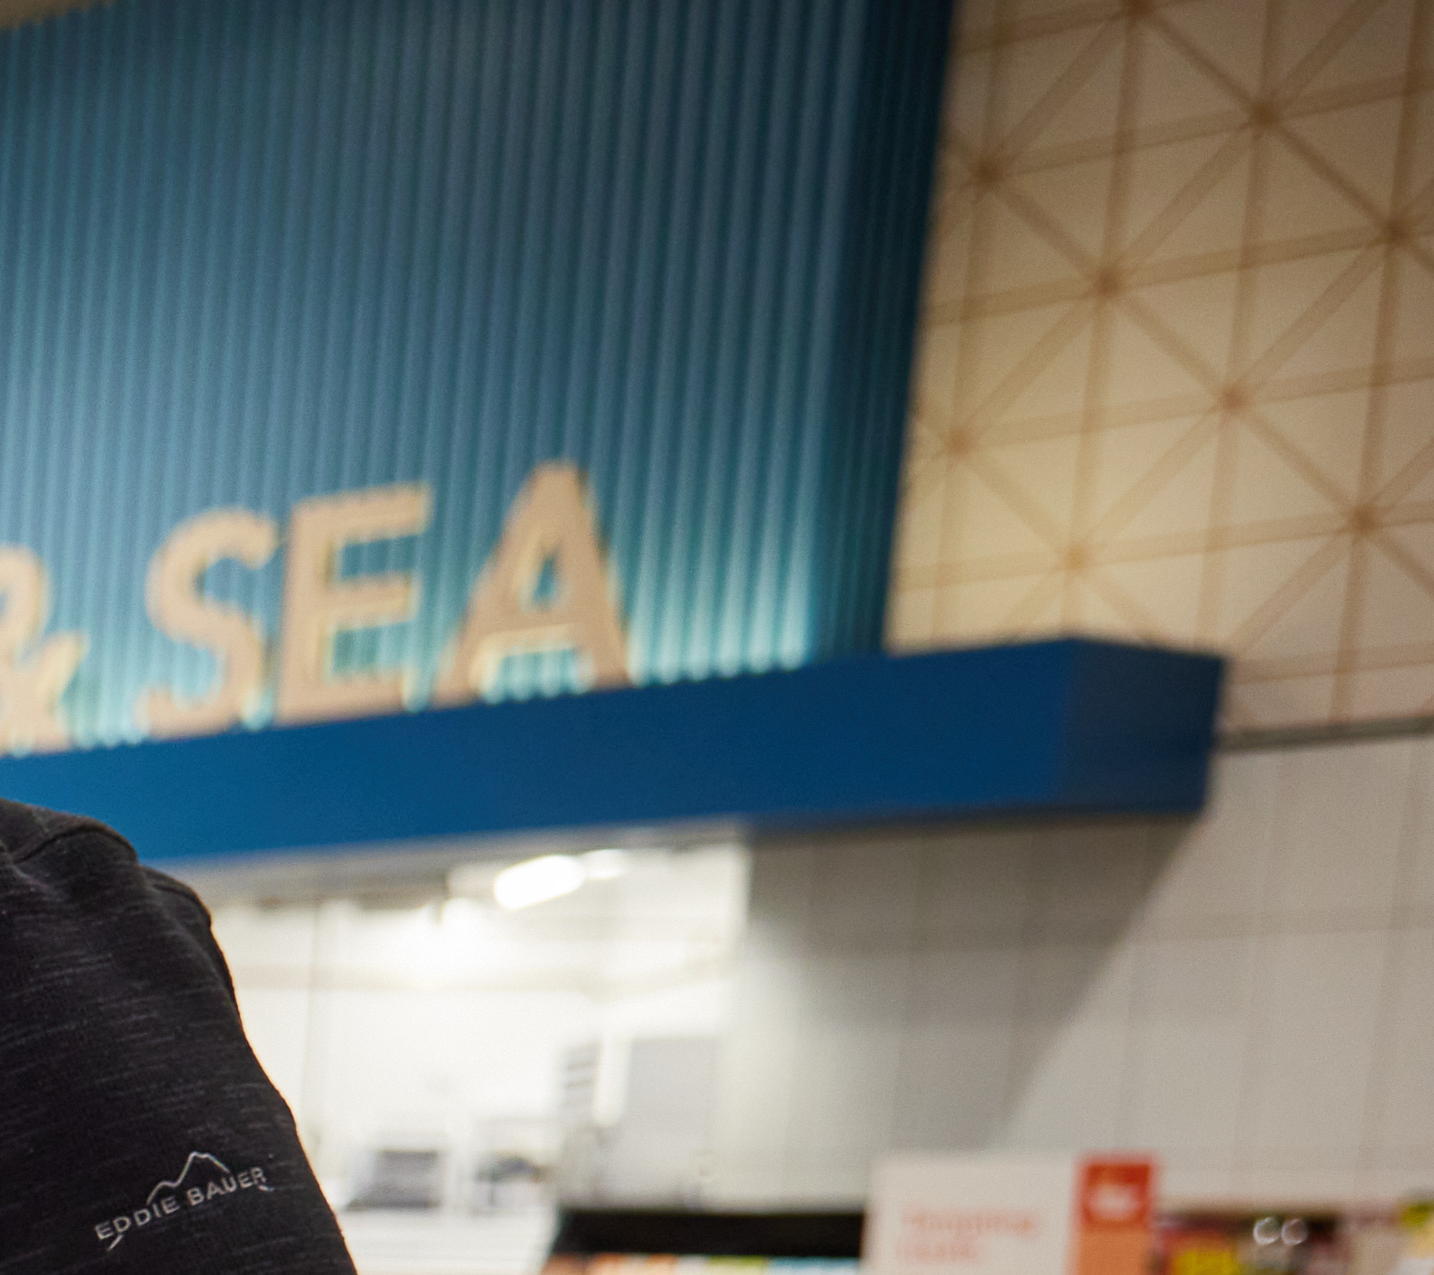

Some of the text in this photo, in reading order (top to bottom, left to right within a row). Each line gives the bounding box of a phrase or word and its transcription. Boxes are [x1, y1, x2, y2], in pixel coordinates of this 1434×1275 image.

[130, 458, 637, 738] SEA
[93, 1166, 268, 1241] EDDIE BAUER
